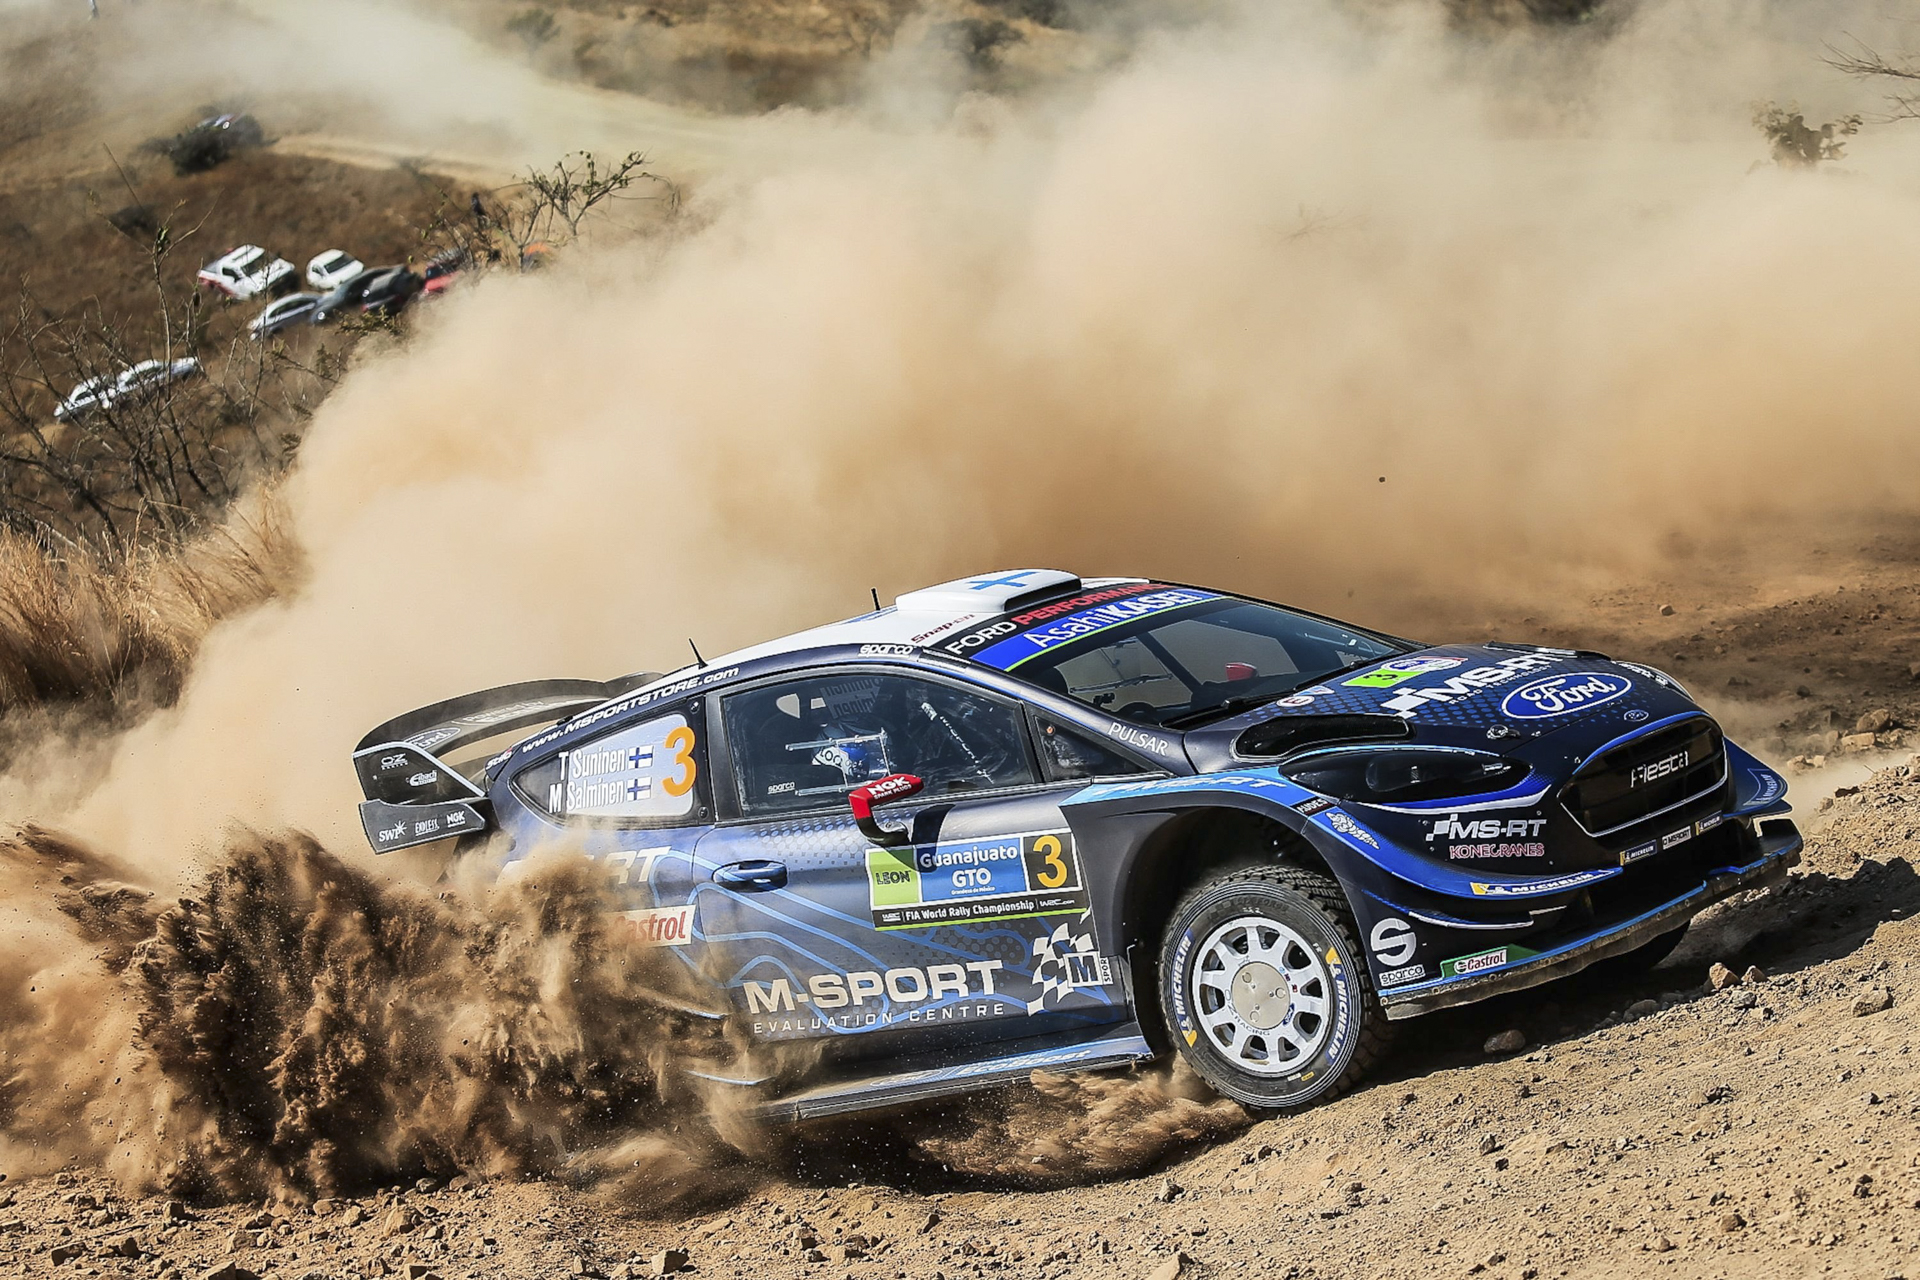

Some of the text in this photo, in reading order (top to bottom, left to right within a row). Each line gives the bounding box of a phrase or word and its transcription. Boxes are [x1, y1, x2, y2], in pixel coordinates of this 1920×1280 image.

[910, 614, 976, 643] Snap-on
[1022, 590, 1203, 648] AsahiKASEI
[945, 621, 1017, 655] FORD
[859, 645, 914, 657] sparco
[1449, 689, 1483, 704] ROAD
[1520, 676, 1617, 711] Ford
[522, 667, 739, 753] www.MSPORTSTORE.com
[1107, 722, 1169, 757] PULSAR
[558, 748, 626, 781] T Suninen
[661, 726, 697, 797] 3
[549, 778, 625, 813] M Salminen
[768, 781, 796, 793] sparco
[867, 776, 911, 795] NGK
[873, 789, 893, 800] SPARK
[446, 811, 466, 825] NGK
[379, 827, 401, 842] SWP
[1450, 819, 1547, 839] MS-RT
[919, 844, 1018, 868] Guanajuato
[1032, 835, 1068, 888] 3
[1449, 844, 1545, 859] KONECRANES
[1630, 846, 1654, 859] MICHELIN
[875, 870, 910, 885] LEON
[952, 867, 992, 888] GTO
[1511, 873, 1594, 893] MICHELIN
[905, 900, 1035, 921] FIA World Rally Championship
[1467, 951, 1504, 971] Castrol
[1173, 935, 1192, 1016] MICHELIN
[1381, 965, 1423, 983] sparco
[743, 959, 1004, 1014] M-SPORT
[753, 1002, 1004, 1034] EVALUATION CENTRE
[1234, 1015, 1271, 1036] RACING
[1328, 979, 1350, 1060] MICHELIN
